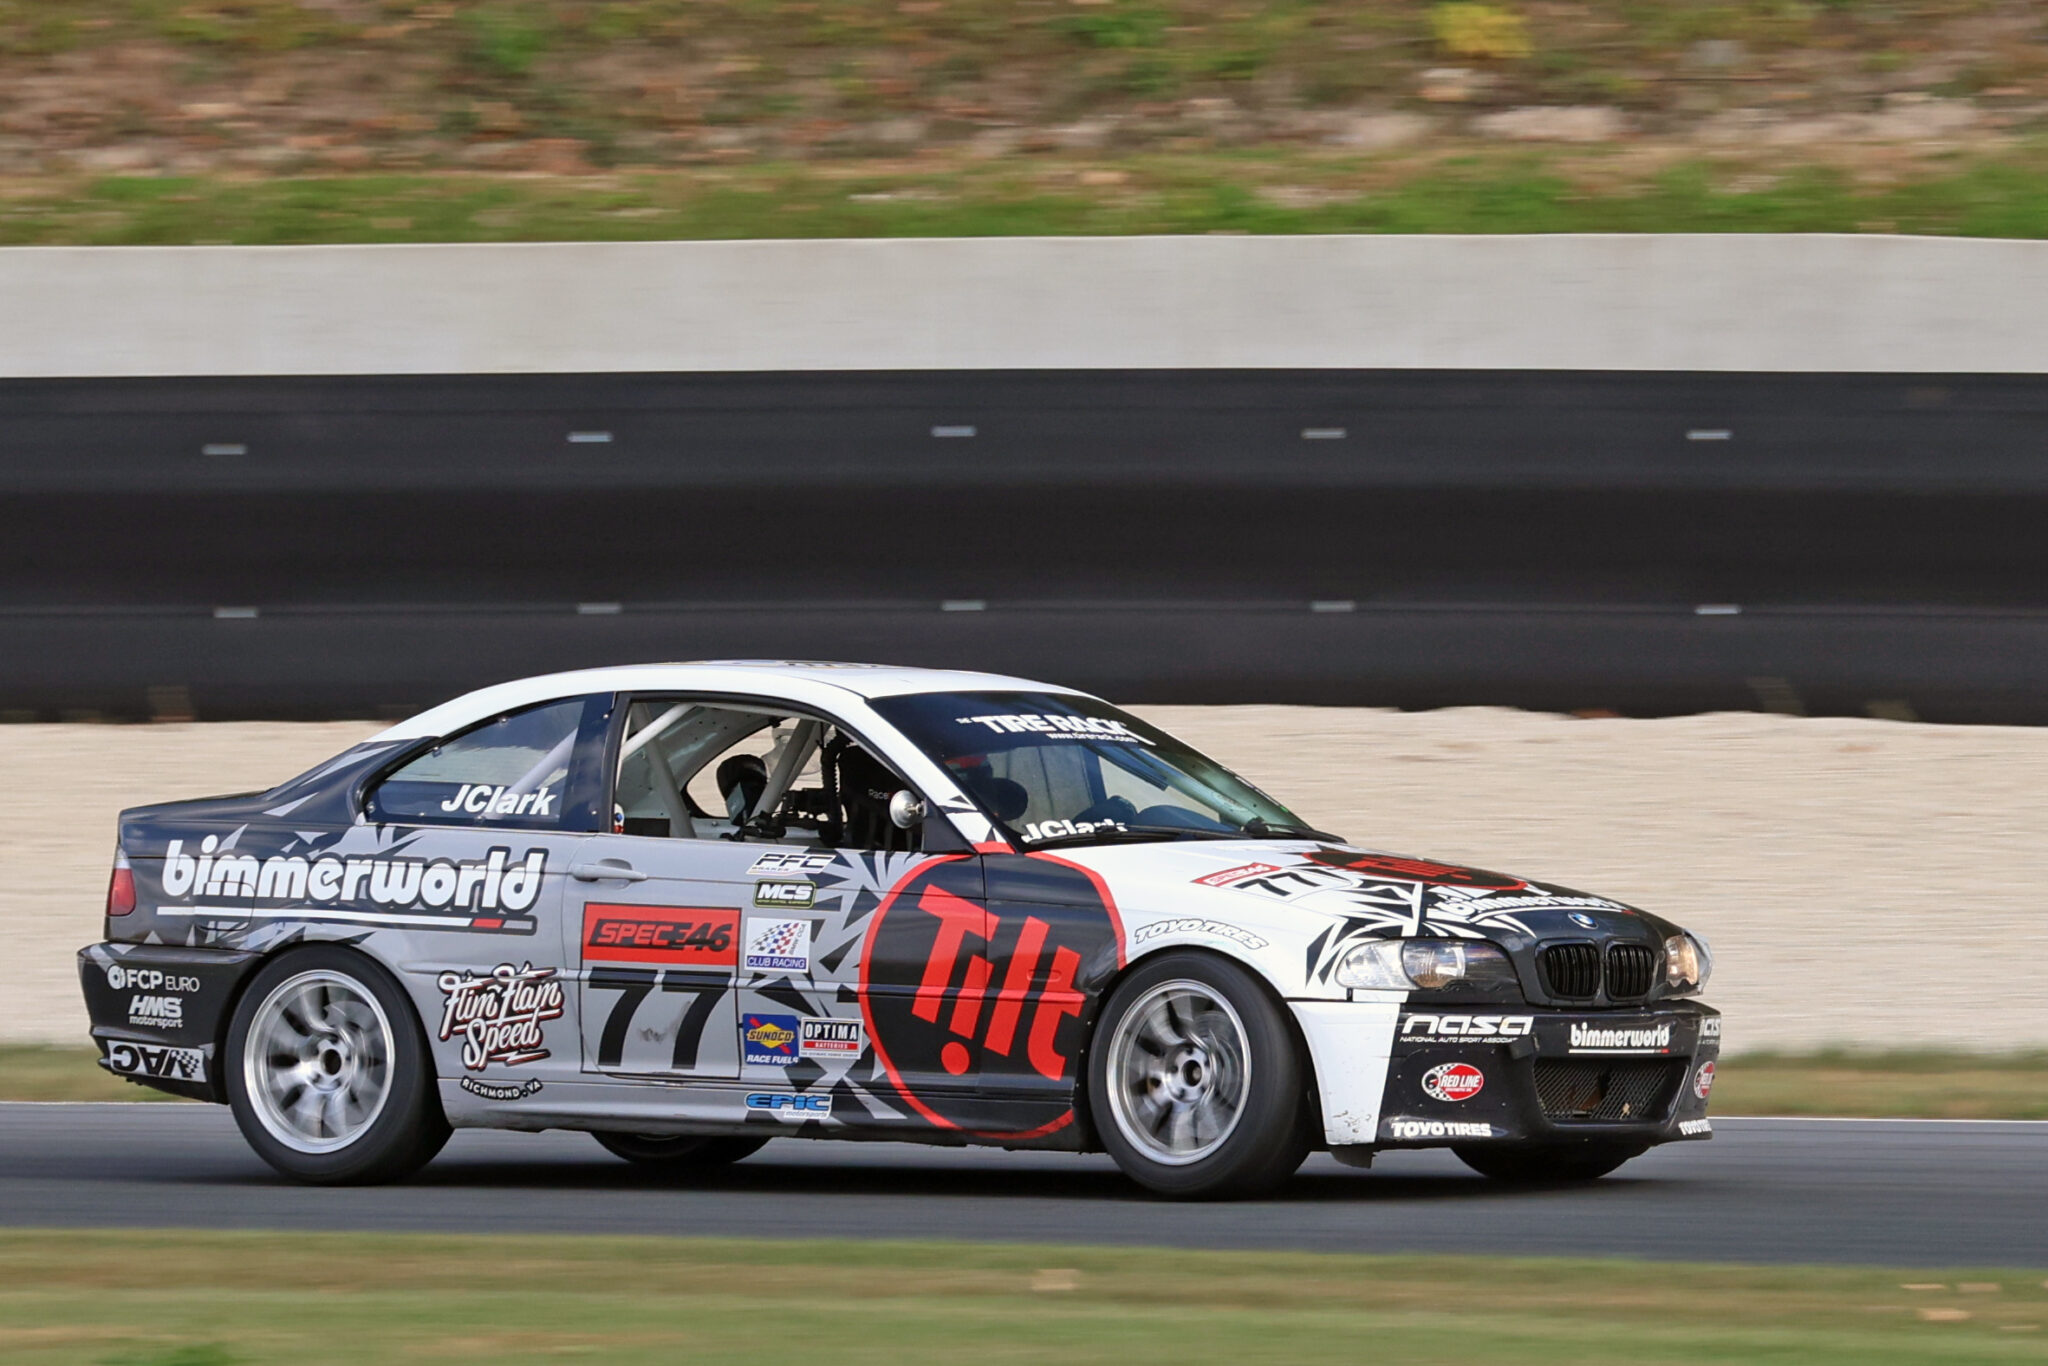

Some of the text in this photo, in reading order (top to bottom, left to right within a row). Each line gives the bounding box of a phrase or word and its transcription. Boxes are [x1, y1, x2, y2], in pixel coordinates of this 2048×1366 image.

[971, 714, 1157, 746] TIRE RACK
[441, 784, 557, 815] JClark
[756, 853, 834, 868] PFC
[162, 834, 544, 911] bimmerworld
[757, 883, 813, 900] MCS
[1134, 918, 1269, 950] TOYO TIRES
[747, 956, 806, 969] CLUB RACING
[126, 969, 200, 992] FCP EURO
[911, 883, 1087, 1082] Tilt
[128, 995, 183, 1018] HMS
[439, 962, 561, 1039] Flim Flam
[129, 1015, 183, 1029] motorsport
[588, 966, 732, 1070] 77
[1401, 1015, 1534, 1035] nasa
[463, 1017, 540, 1068] Speed
[748, 1030, 793, 1042] SUNOCO
[805, 1023, 858, 1041] OPTIMA
[1570, 1022, 1671, 1047] bimmerworld
[113, 1045, 199, 1079] VAC
[746, 1054, 770, 1063] RACE
[772, 1055, 799, 1064] FUELS
[461, 1078, 542, 1098] RICHMOND VA
[1440, 1075, 1480, 1087] RED LINE
[745, 1093, 830, 1111] EPIC
[1391, 1122, 1493, 1137] TOYO TIRES
